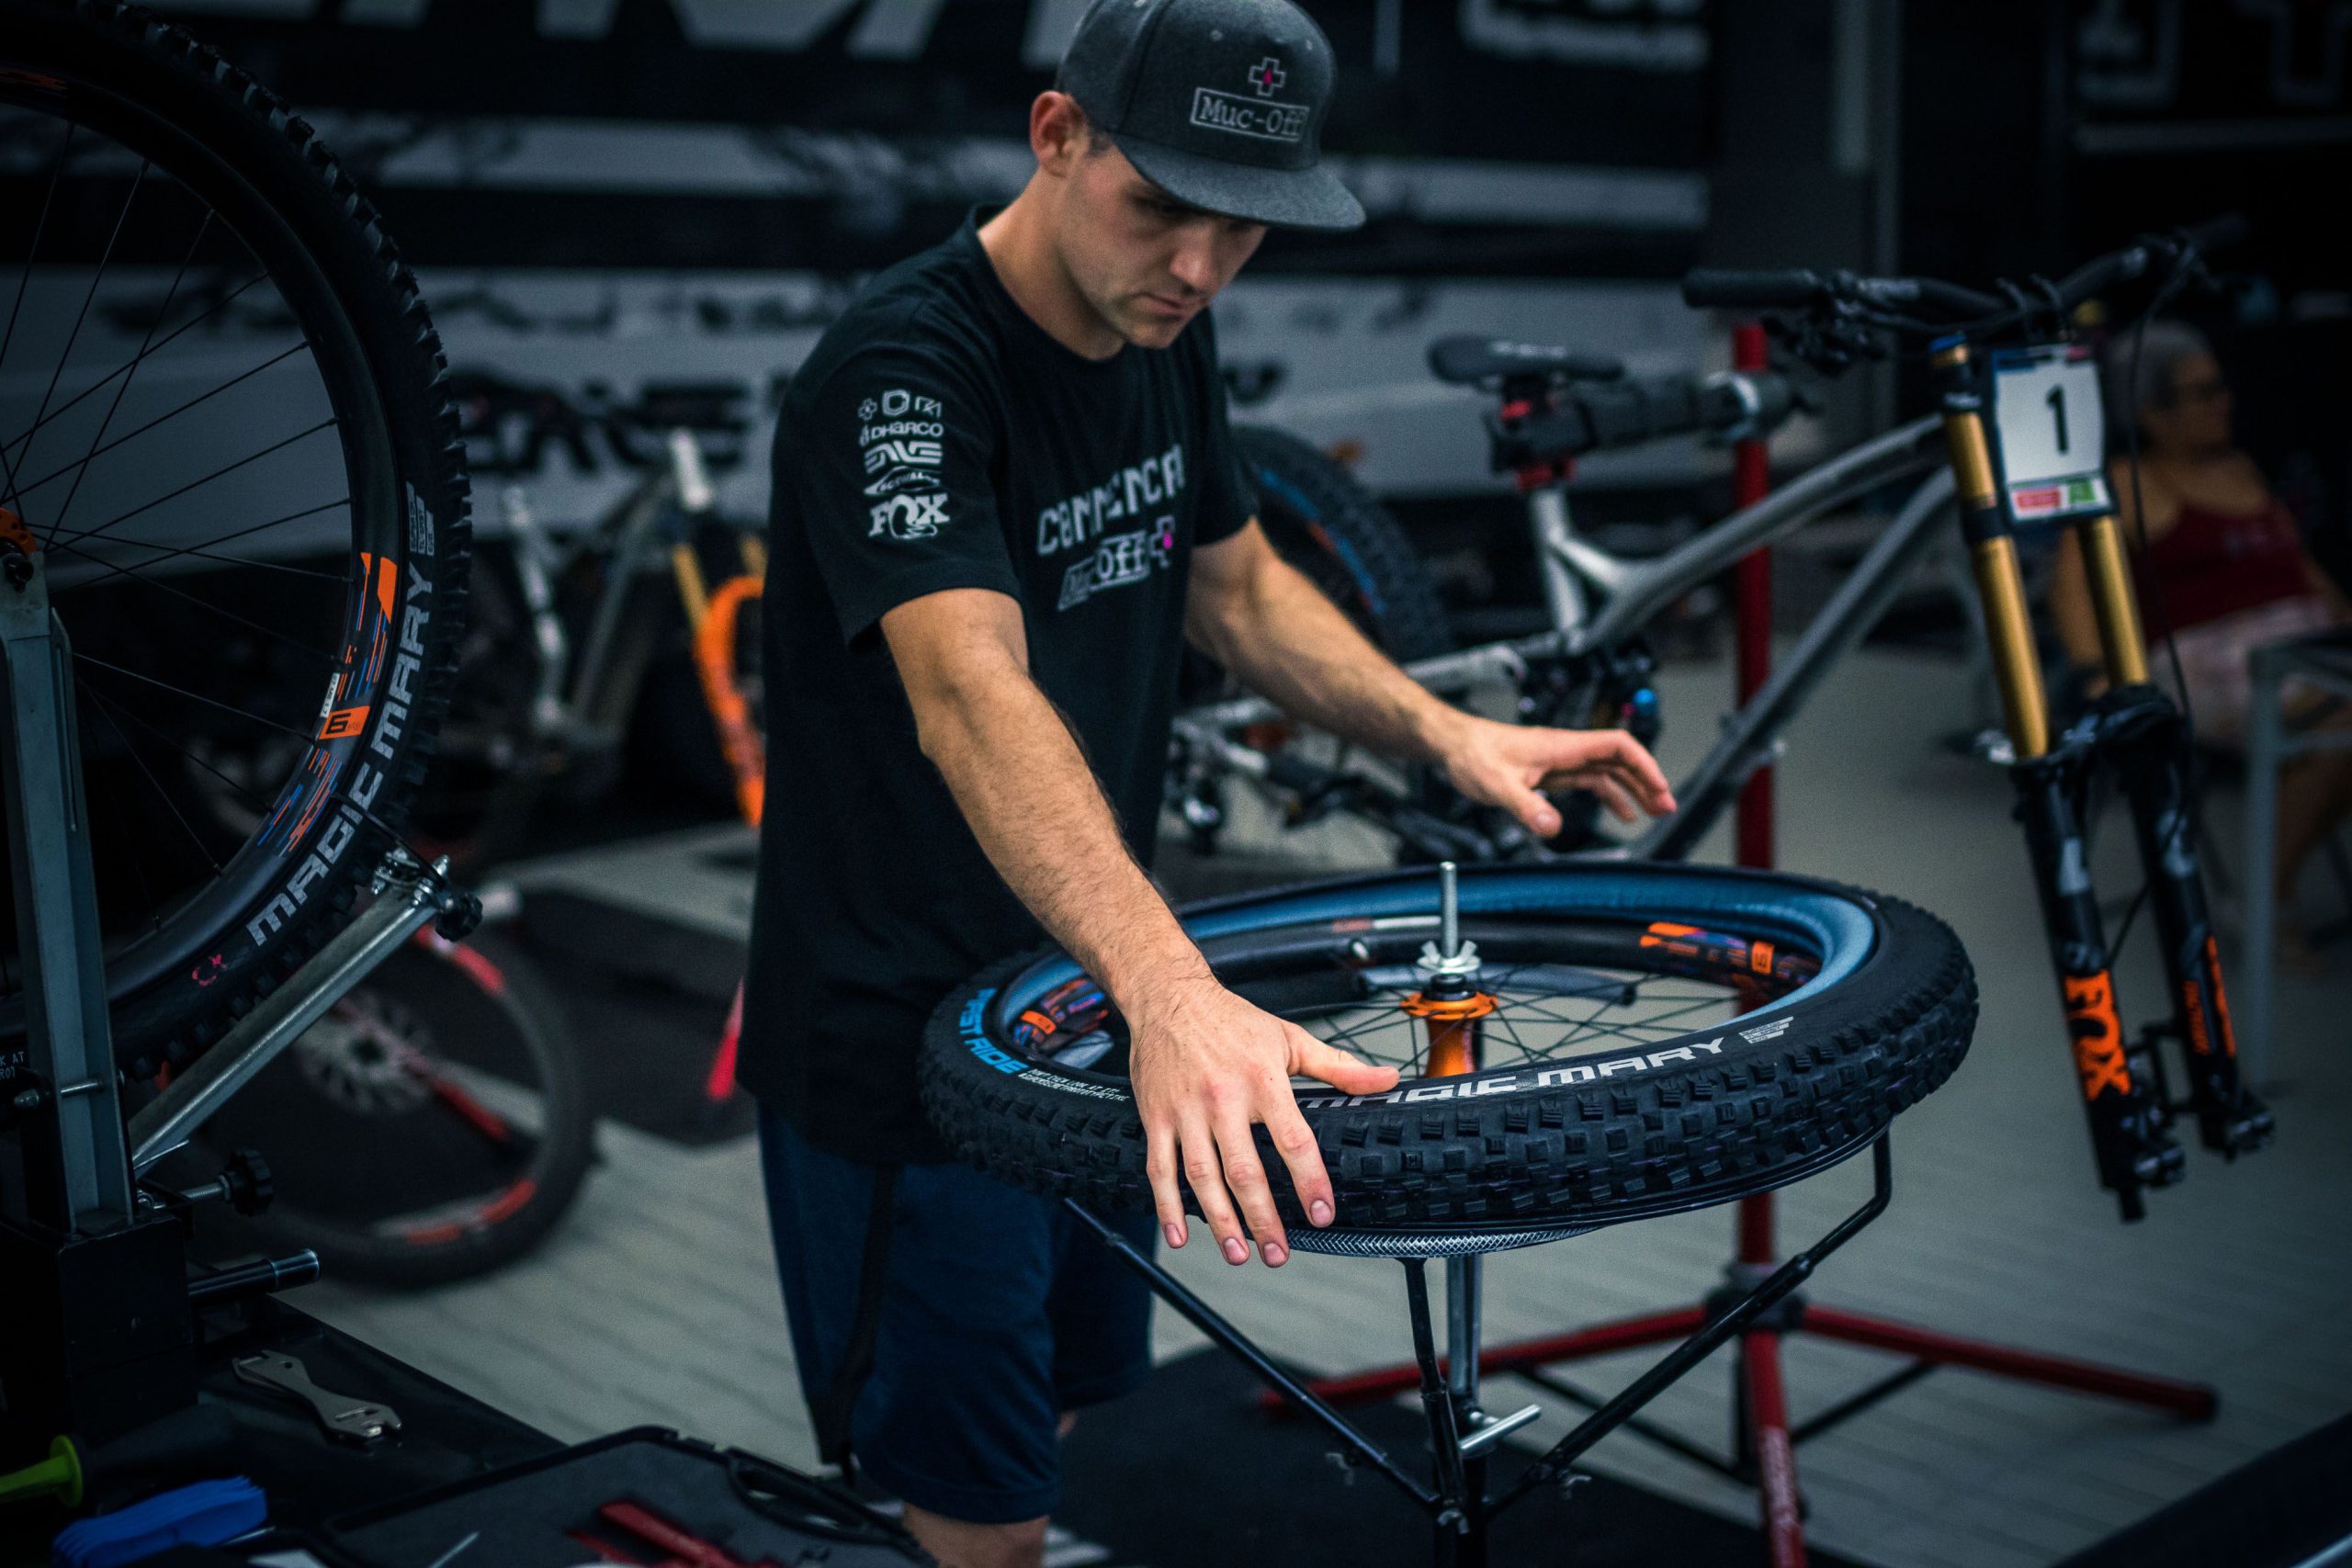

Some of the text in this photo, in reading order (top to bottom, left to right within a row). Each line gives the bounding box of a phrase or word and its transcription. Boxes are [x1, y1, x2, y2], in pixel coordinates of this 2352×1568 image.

[1198, 96, 1305, 136] Muc-Off
[2046, 383, 2068, 455] 1
[867, 493, 951, 540] FOX
[246, 562, 433, 947] MAGIC MARY
[965, 1035, 1030, 1075] RIDE
[1538, 1037, 1724, 1088] MARY
